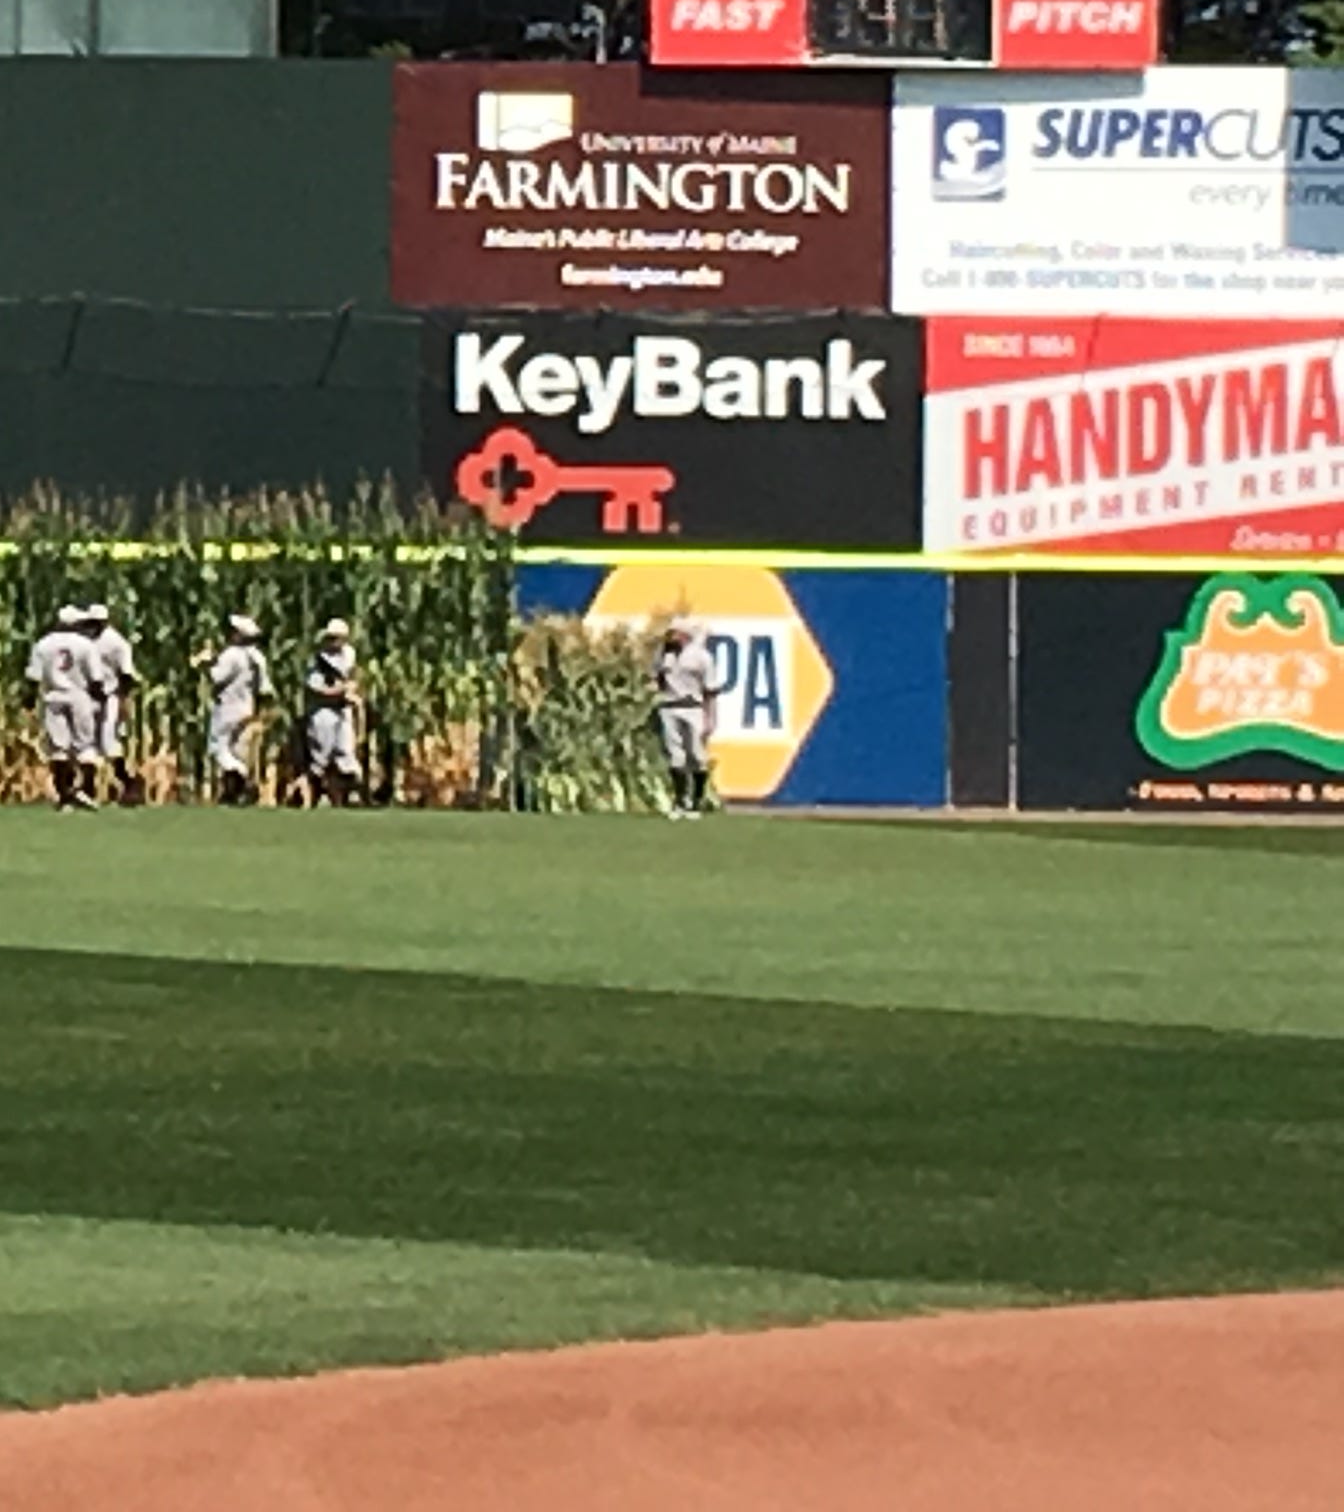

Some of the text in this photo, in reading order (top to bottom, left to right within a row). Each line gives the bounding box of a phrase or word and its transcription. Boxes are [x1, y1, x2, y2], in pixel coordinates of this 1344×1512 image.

[1007, 0, 1144, 33] PITCH
[434, 152, 851, 213] FARMINGTON
[1189, 184, 1272, 211] every
[455, 332, 887, 433] KeyBank
[963, 480, 1210, 541] EQUIPMENT
[1196, 687, 1313, 717] PIZZA
